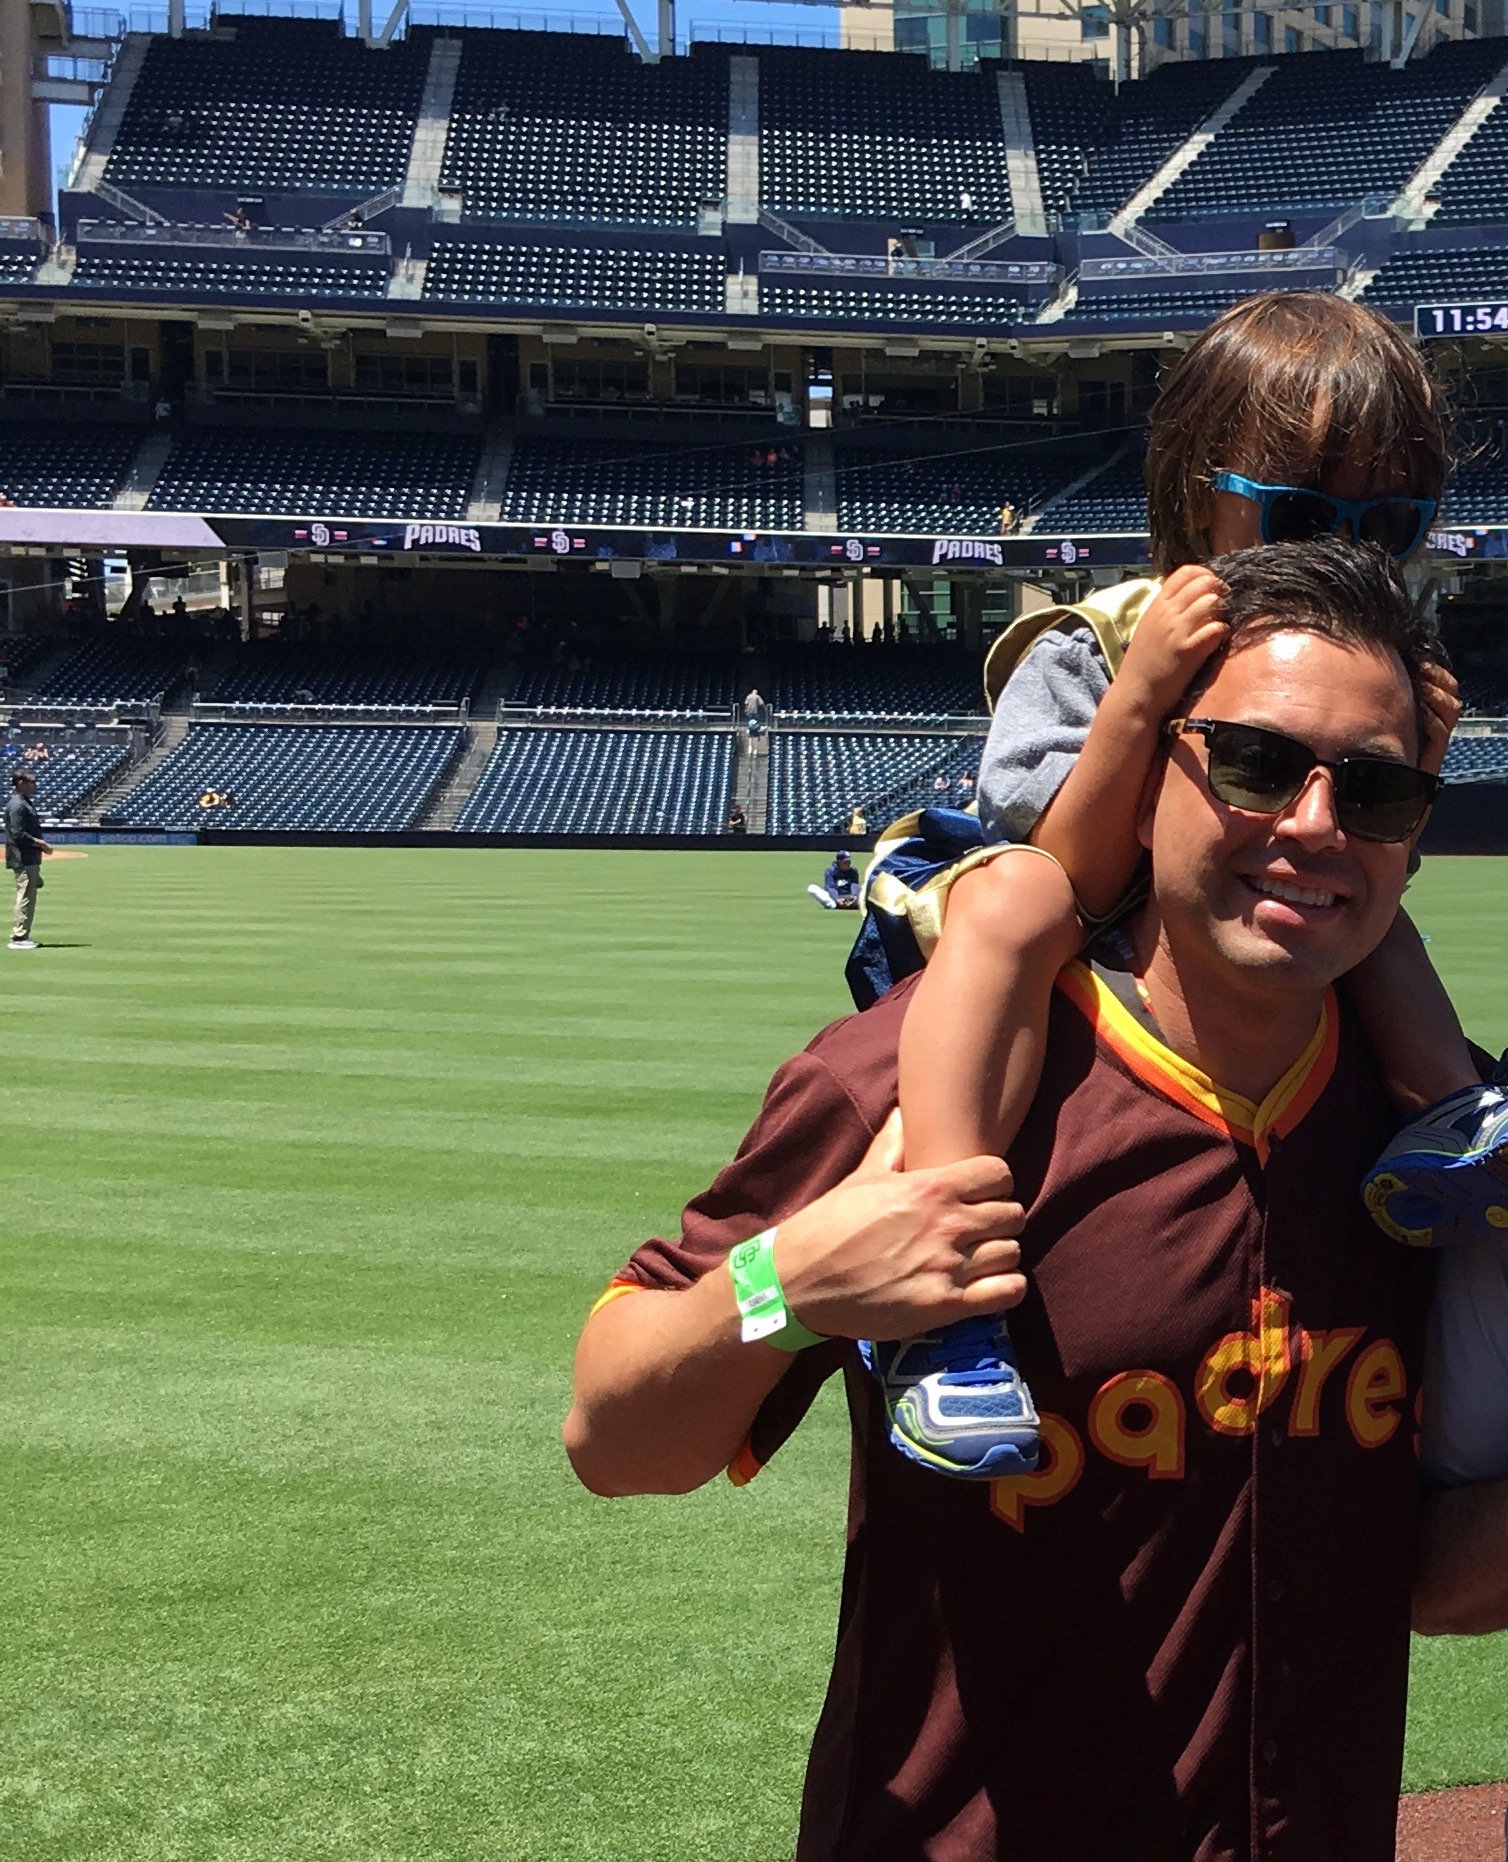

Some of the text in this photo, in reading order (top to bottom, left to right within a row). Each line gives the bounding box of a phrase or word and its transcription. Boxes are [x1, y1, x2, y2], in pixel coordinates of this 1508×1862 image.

[404, 524, 481, 551] PADRES
[932, 539, 1003, 565] PADRES
[990, 1284, 1423, 1534] padre
